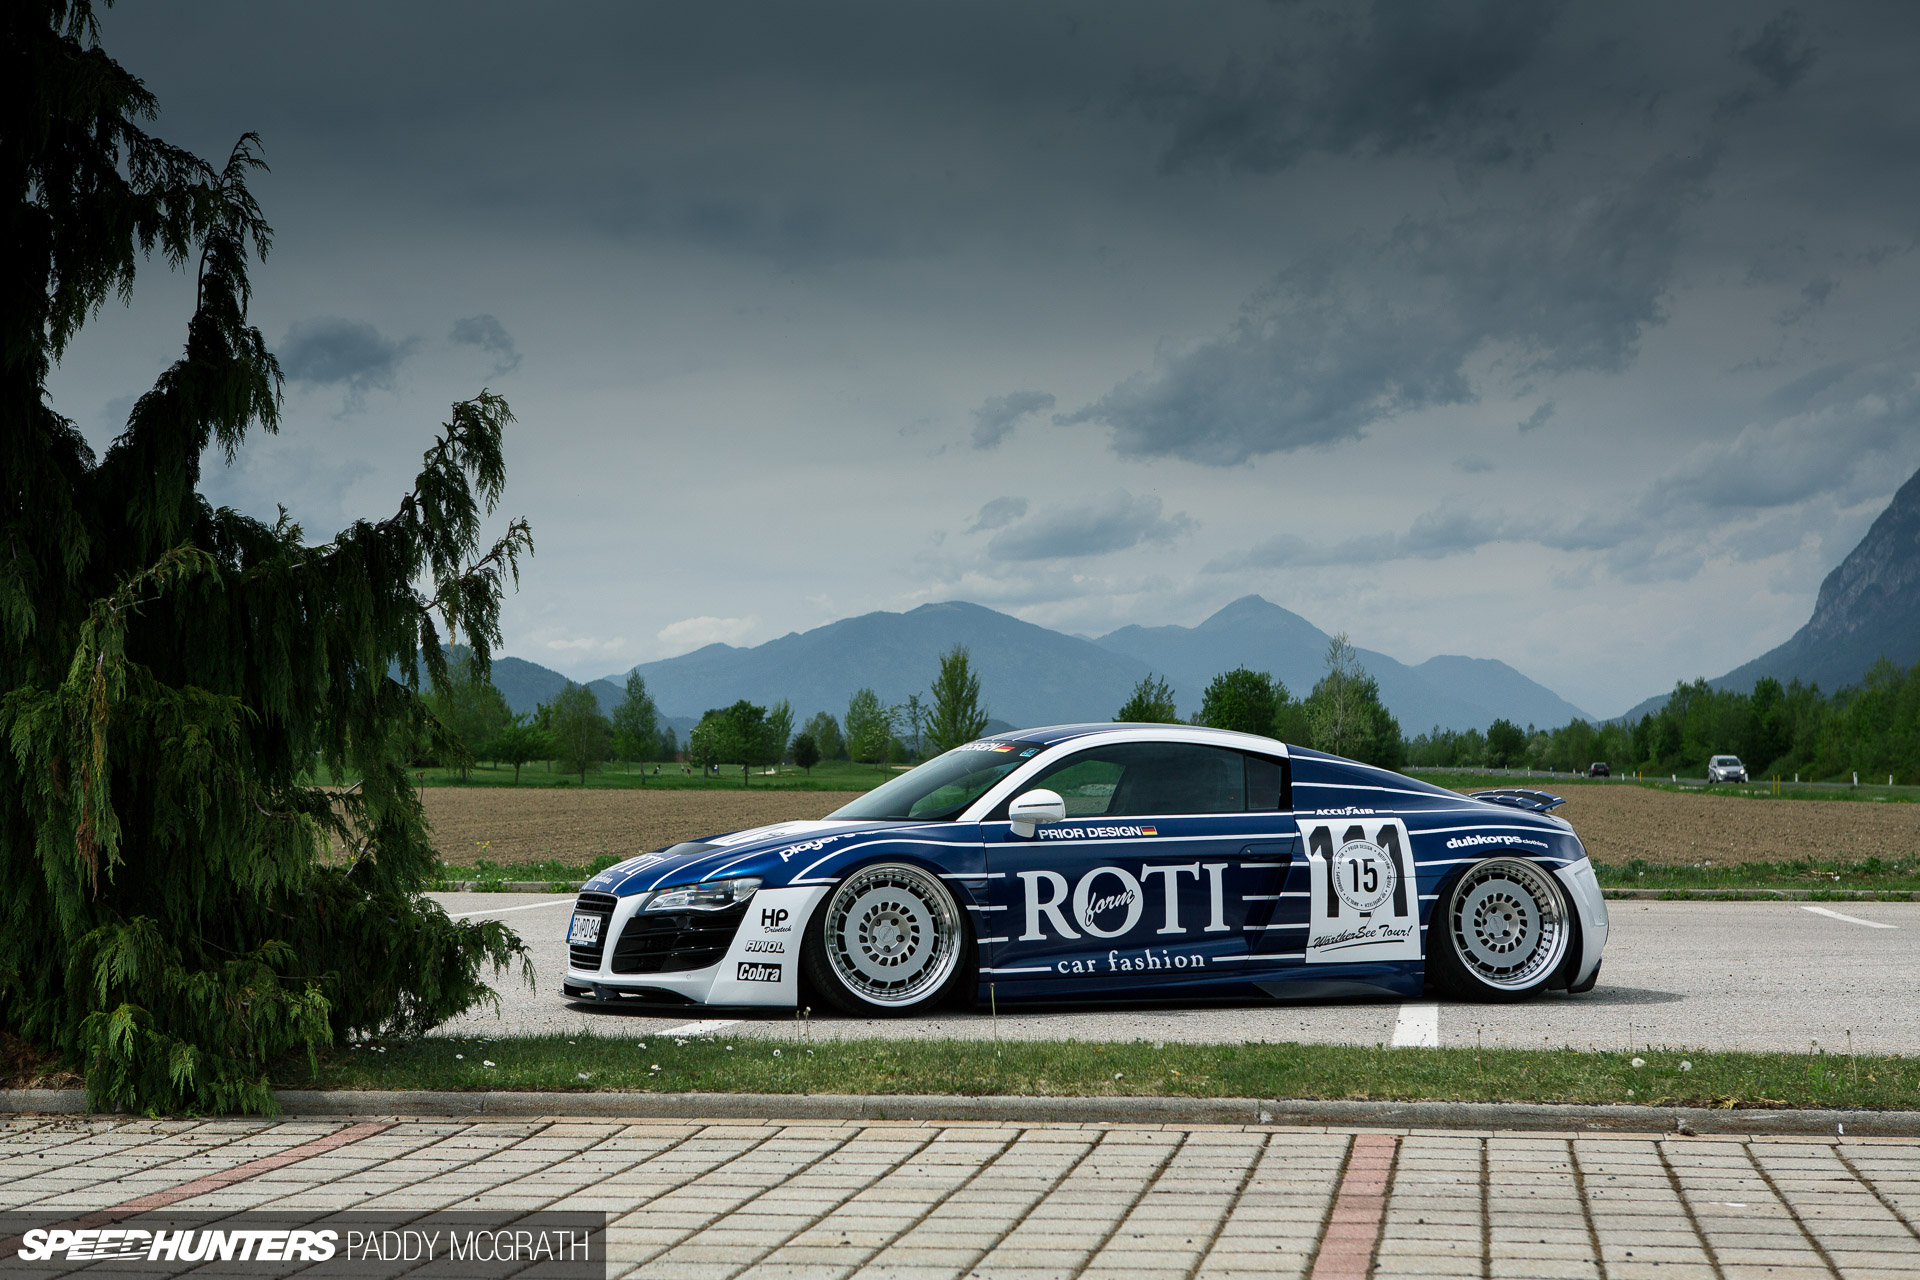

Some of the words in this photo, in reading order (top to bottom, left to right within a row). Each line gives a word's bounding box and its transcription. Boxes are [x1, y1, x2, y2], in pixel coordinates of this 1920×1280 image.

[1038, 828, 1085, 839] PRIOR
[1086, 826, 1141, 838] DESIGN
[1446, 835, 1523, 849] dubkorps
[1348, 858, 1378, 893] 15
[1017, 862, 1230, 941] ROTI
[1085, 889, 1135, 927] form
[761, 908, 789, 927] HP
[764, 925, 792, 933] Drivetech
[1378, 924, 1413, 937] Tour!
[745, 940, 785, 953] AWOL
[1057, 958, 1096, 974] car
[1108, 949, 1205, 973] fashion
[738, 963, 780, 981] Cobra
